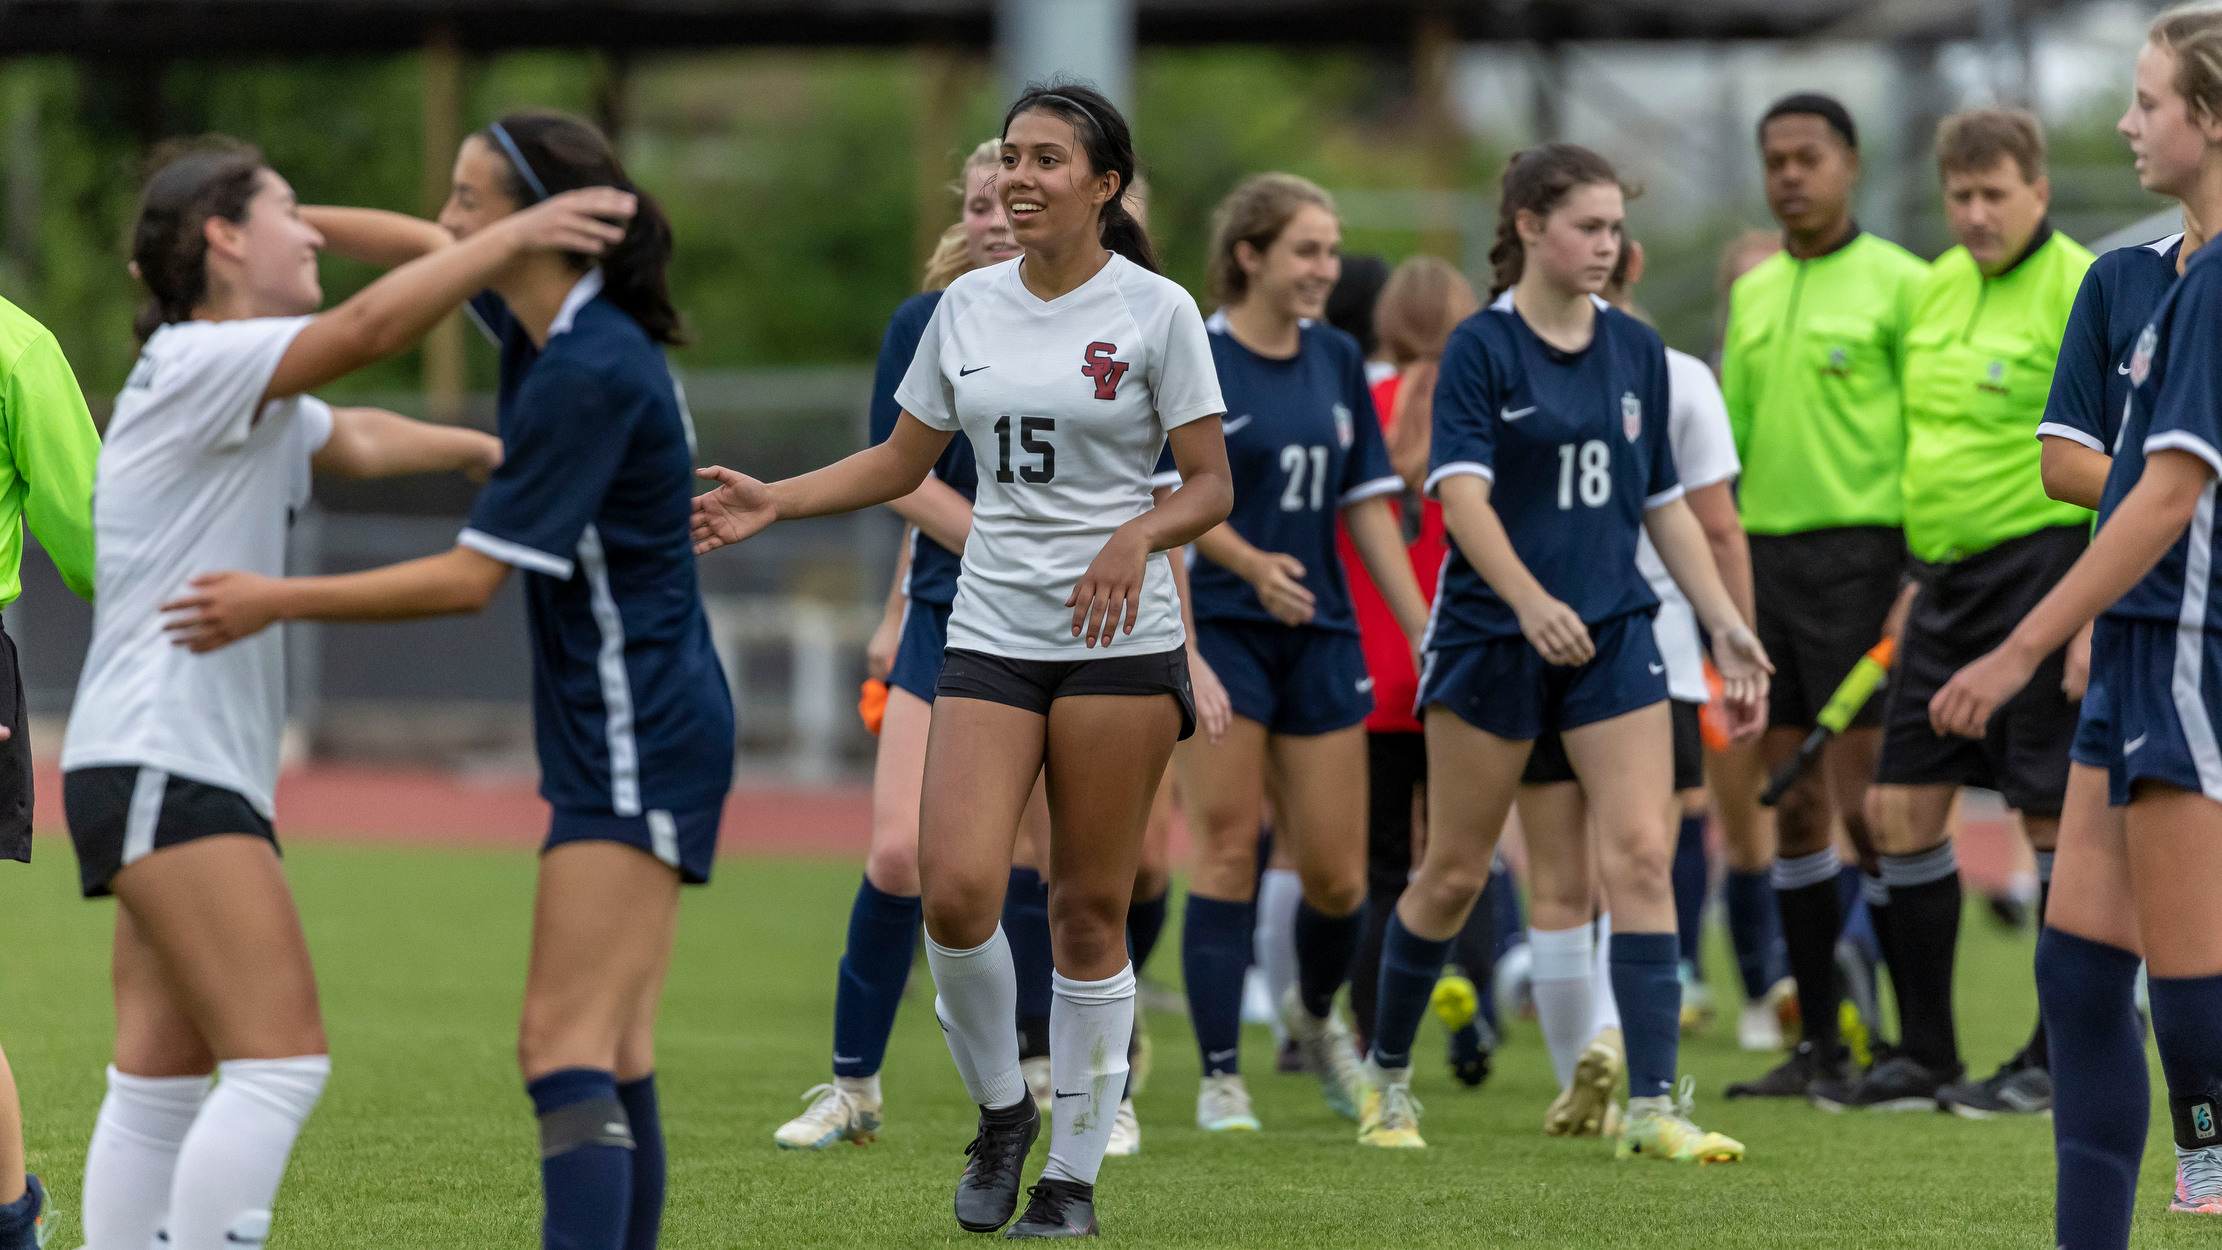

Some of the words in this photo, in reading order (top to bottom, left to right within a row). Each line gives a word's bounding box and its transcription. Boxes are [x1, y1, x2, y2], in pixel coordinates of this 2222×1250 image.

[1081, 341, 1129, 400] SV
[994, 415, 1055, 484] 15
[1280, 444, 1329, 512] 21
[1558, 440, 1611, 510] 18
